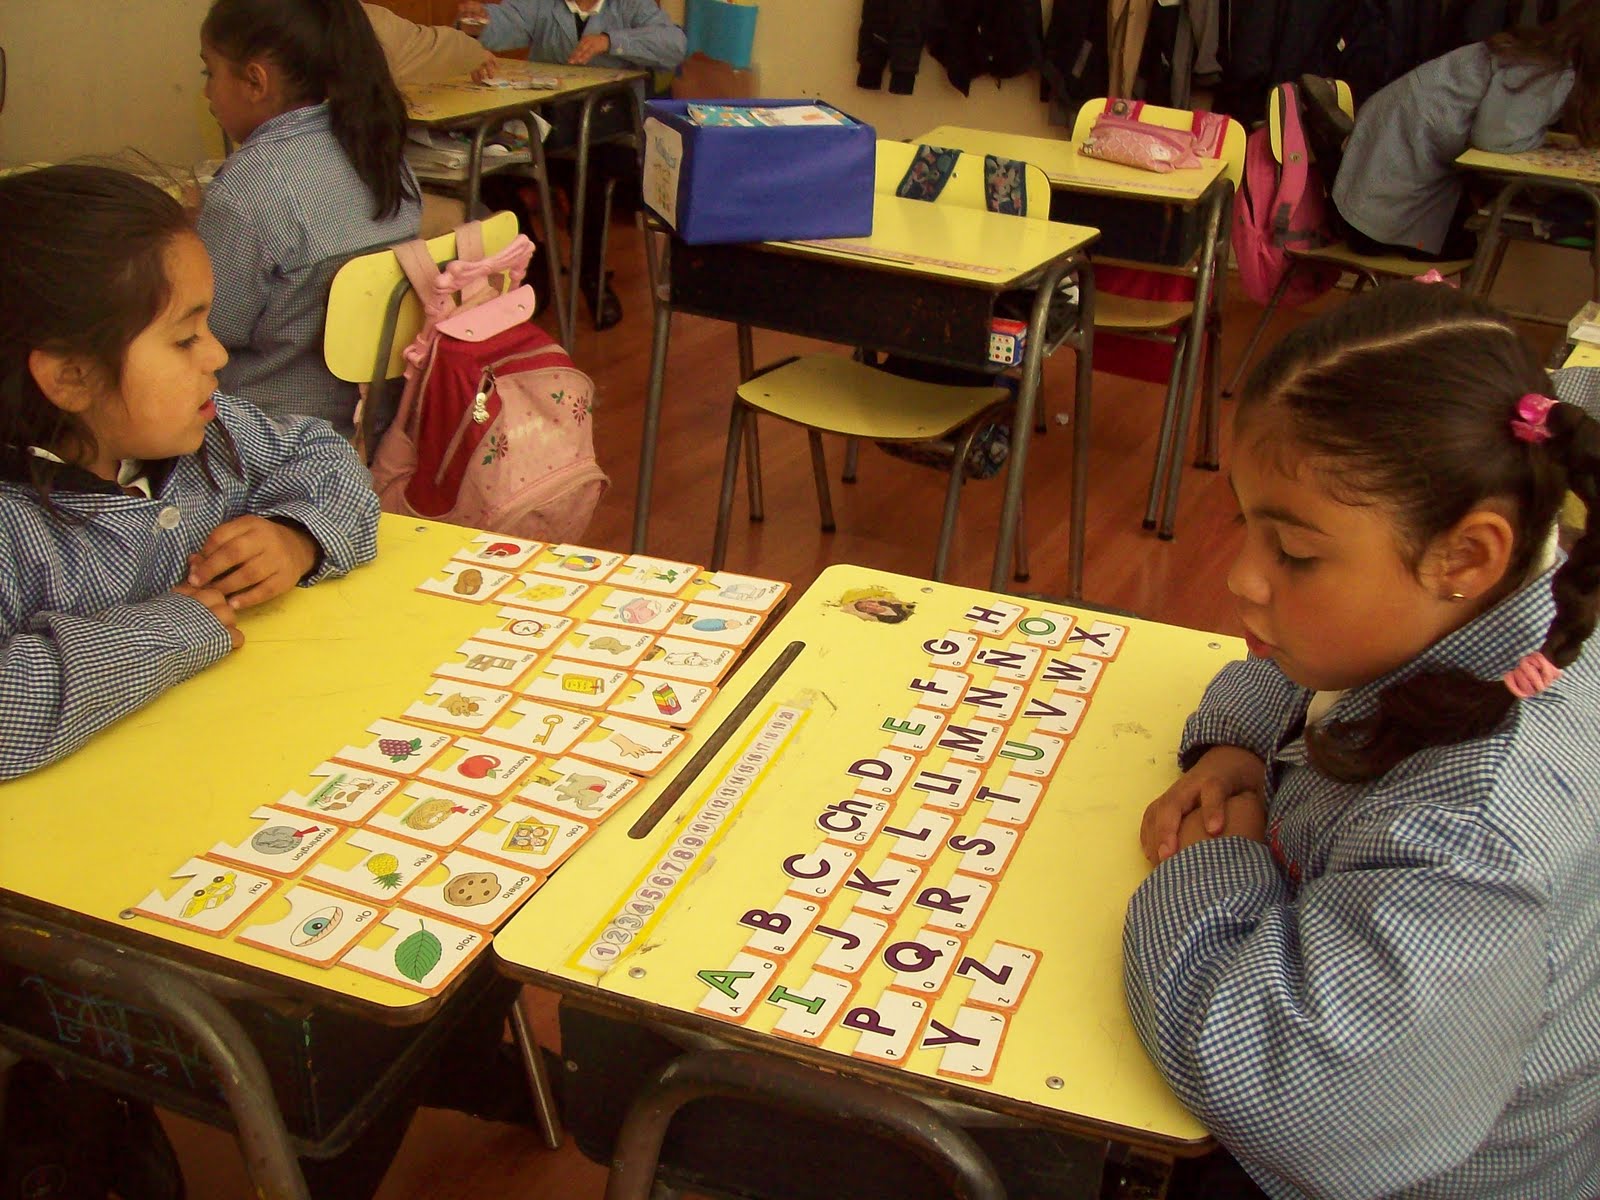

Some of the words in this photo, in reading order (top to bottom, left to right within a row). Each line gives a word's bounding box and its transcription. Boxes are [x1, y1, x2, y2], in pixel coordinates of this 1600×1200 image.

[965, 606, 1007, 625] H
[1018, 617, 1056, 636] O
[1068, 626, 1110, 647] X
[923, 639, 960, 655] G
[976, 649, 1027, 669] Ñ
[1042, 658, 1086, 681] W
[909, 678, 948, 694] F
[963, 686, 1008, 709] N
[1024, 698, 1067, 716] V
[882, 717, 926, 736] E
[430, 735, 448, 748] Uvas
[661, 734, 680, 748] Dedo
[938, 725, 988, 753] M
[1000, 740, 1044, 761] U
[501, 755, 531, 779] Manzana
[847, 759, 893, 781] D
[374, 780, 395, 796] Vaca
[729, 775, 747, 786] 14
[606, 778, 634, 800] Elefante
[720, 786, 738, 797] 13
[976, 786, 1021, 803] T
[469, 803, 488, 817] Nido
[711, 799, 729, 809] 12
[701, 811, 720, 822] 11
[818, 800, 873, 832] Ch
[566, 824, 584, 838] Foto
[692, 823, 711, 834] 10
[882, 826, 932, 841] L
[292, 827, 334, 861] Washington
[682, 836, 705, 847] 9
[949, 835, 996, 856] S
[413, 853, 433, 868] Piña
[672, 849, 695, 861] 8
[661, 862, 684, 874] 7
[783, 854, 831, 879] C
[249, 881, 268, 895] Taxi
[502, 876, 530, 899] Galleta
[652, 875, 674, 887] 6
[845, 867, 900, 897] K
[641, 888, 664, 900] 5
[915, 887, 972, 914] R
[631, 902, 654, 914] 4
[355, 910, 372, 923] Ojo
[618, 916, 642, 929] 3
[739, 909, 792, 935] B
[456, 934, 477, 951] Hoja
[607, 929, 630, 944] 2
[814, 925, 861, 950] J
[946, 939, 958, 947] q
[596, 946, 617, 958] 1
[884, 941, 944, 973] Q
[956, 956, 1013, 986] Z
[697, 969, 755, 1000] A
[923, 981, 935, 989] Q
[767, 985, 827, 1015] I
[912, 1001, 923, 1009] p
[998, 996, 1010, 1004] Z
[729, 1005, 741, 1014] A
[842, 1007, 896, 1037] P
[922, 1019, 981, 1047] Y
[885, 1049, 897, 1057] P
[971, 1064, 984, 1073] Y
